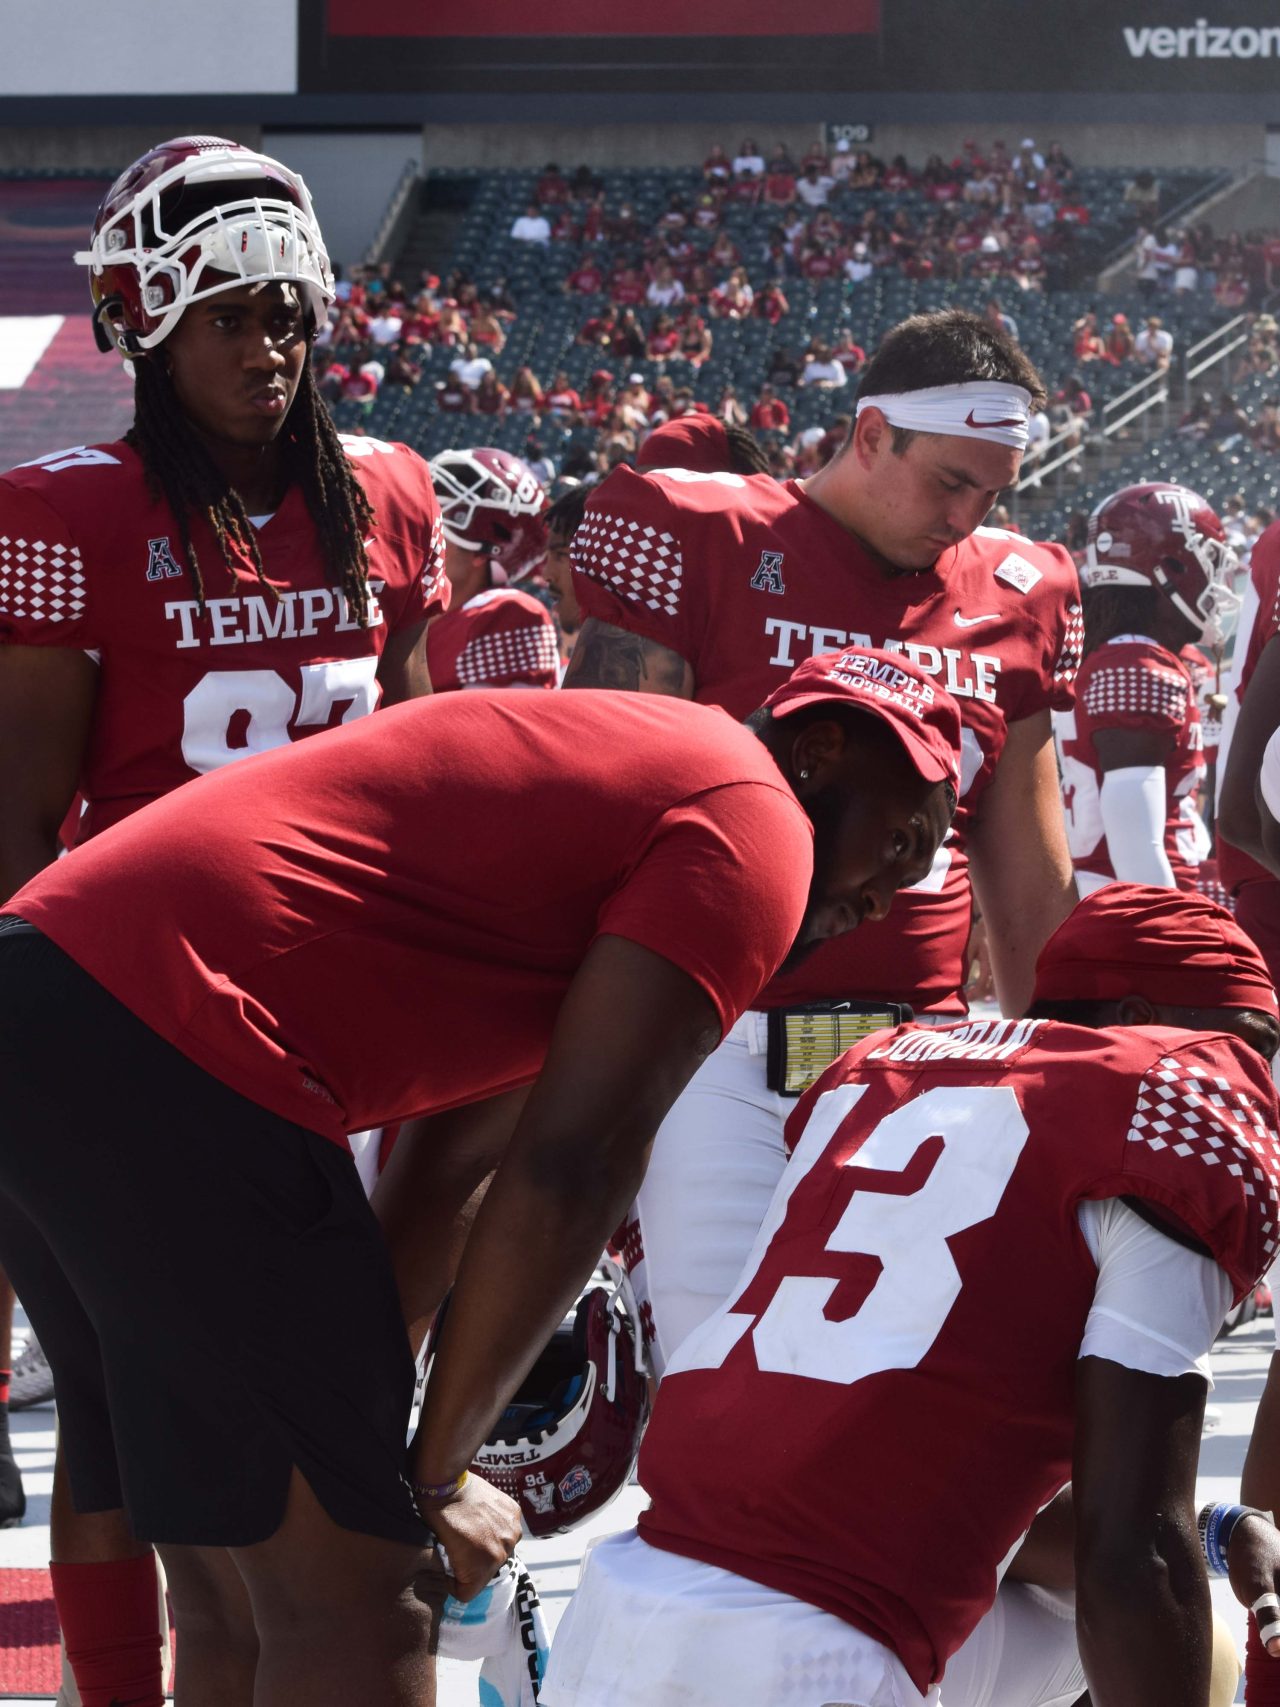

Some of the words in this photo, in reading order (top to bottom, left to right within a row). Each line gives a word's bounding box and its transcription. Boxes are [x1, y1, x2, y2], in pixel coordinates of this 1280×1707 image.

[164, 579, 386, 649] TEMPLE
[823, 669, 925, 719] FOOTBALL
[834, 653, 936, 705] TEMPLE
[181, 656, 381, 776] 97
[866, 1018, 1049, 1062] JORDAN
[660, 1083, 1030, 1385] 13
